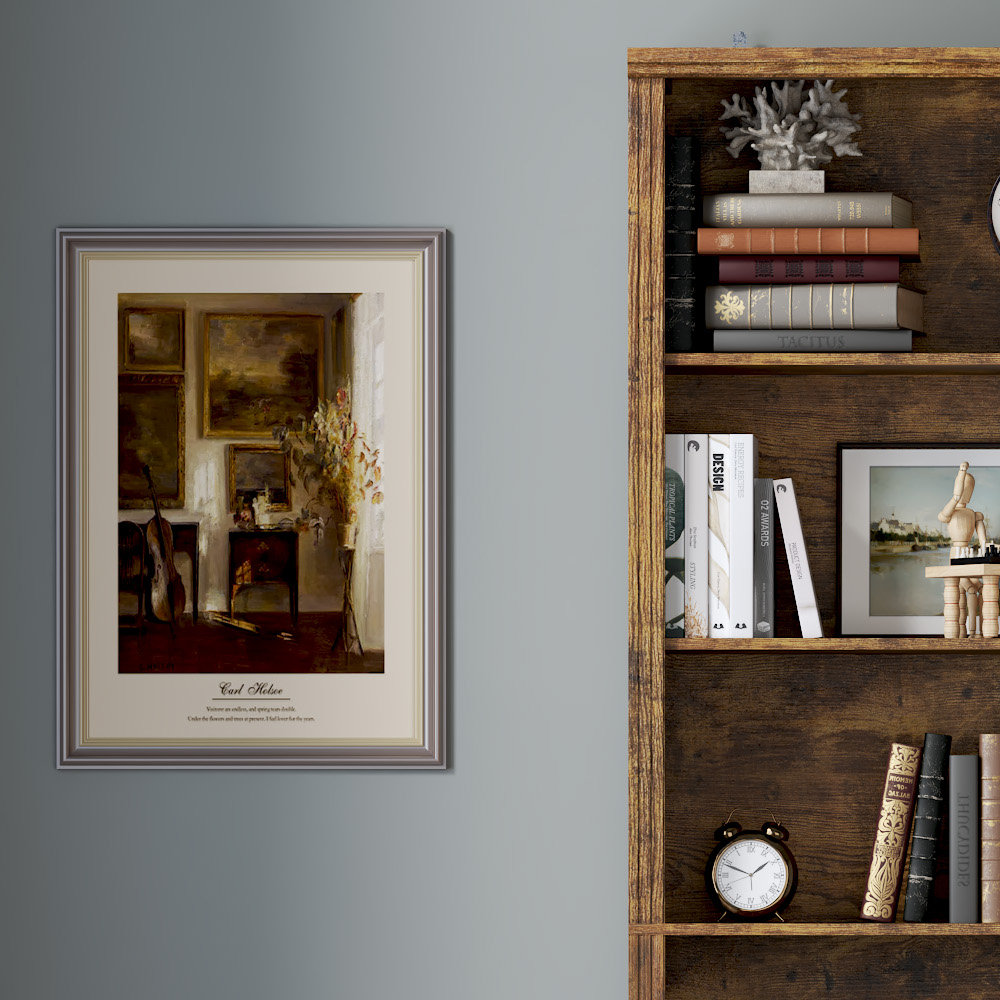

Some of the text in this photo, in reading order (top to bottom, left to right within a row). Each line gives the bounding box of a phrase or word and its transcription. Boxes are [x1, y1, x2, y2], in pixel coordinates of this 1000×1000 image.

[777, 335, 845, 348] TACITUS
[712, 453, 724, 491] DESIGN
[760, 512, 769, 547] AWARDS
[219, 681, 244, 695] Carl
